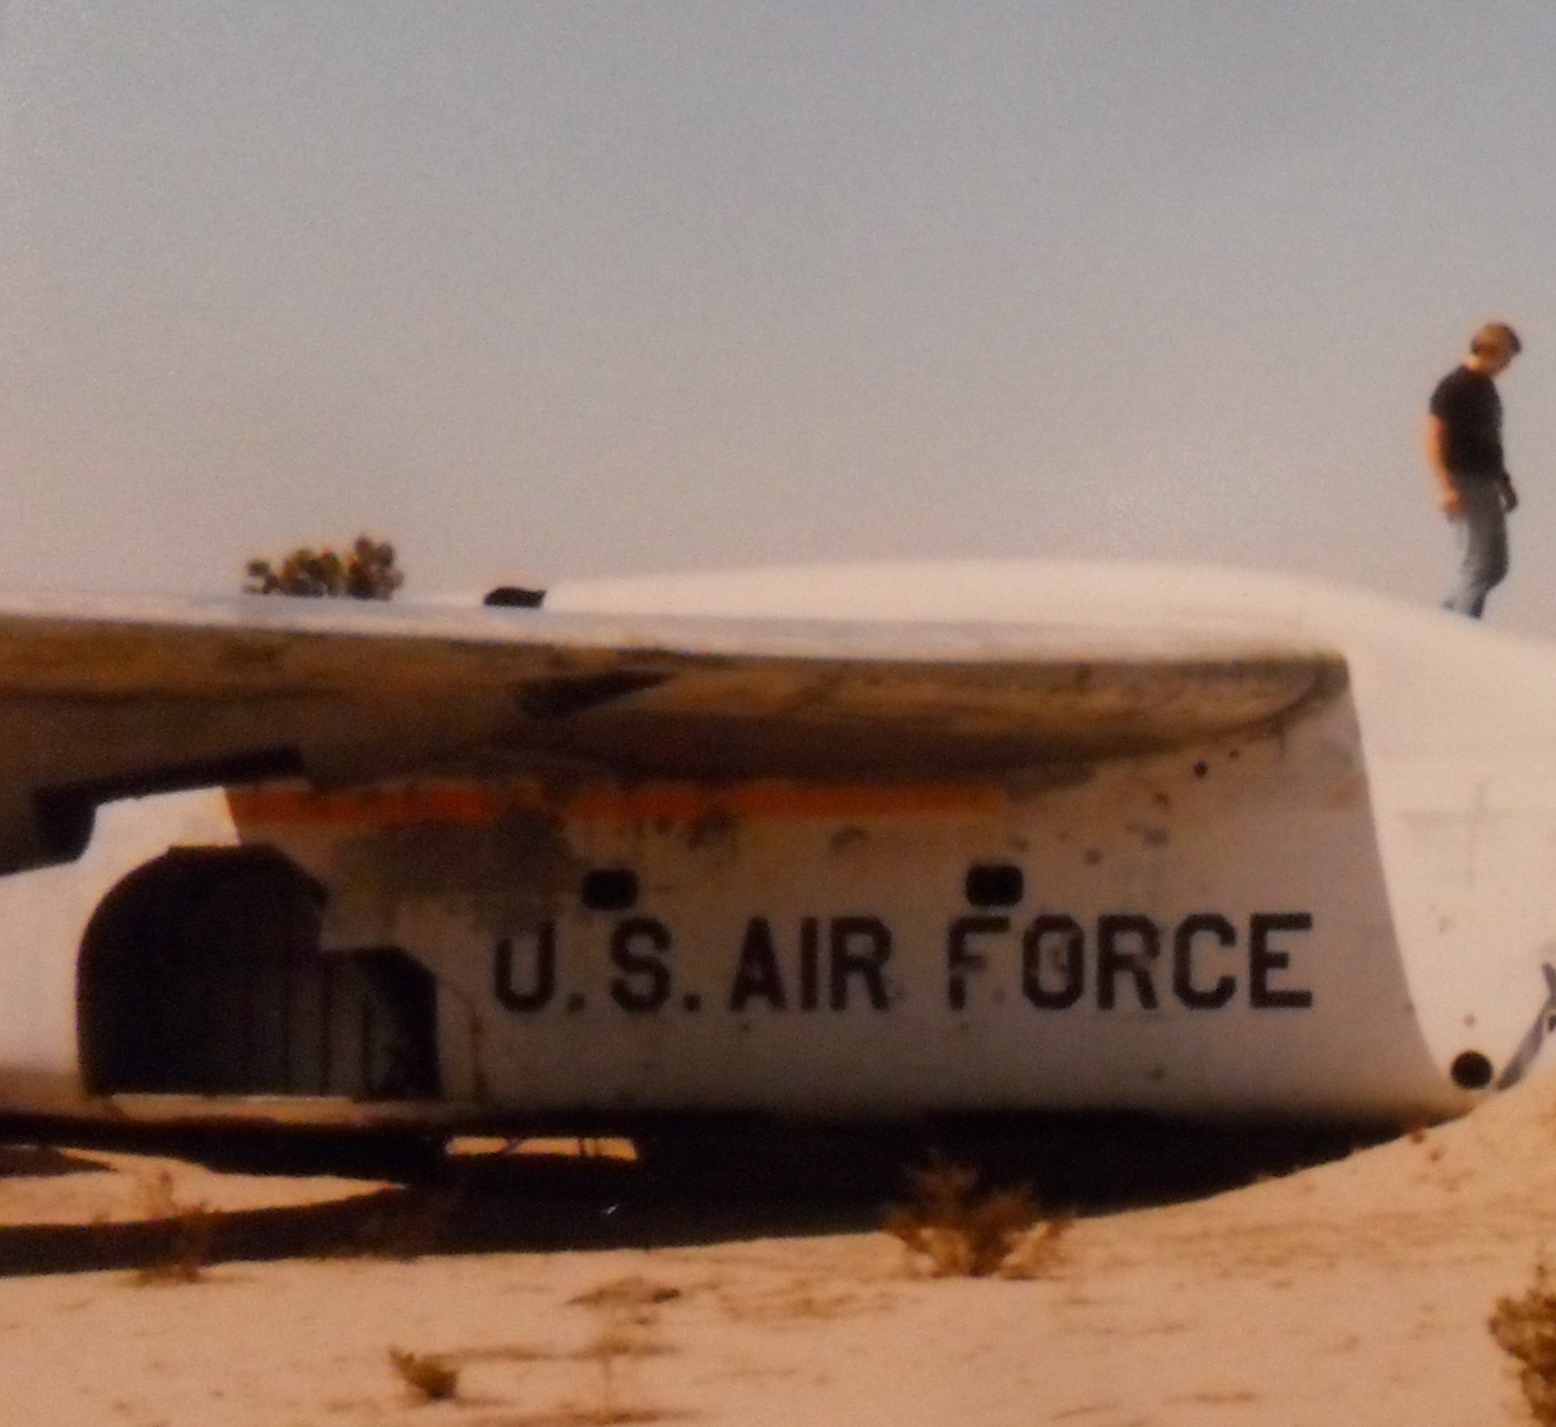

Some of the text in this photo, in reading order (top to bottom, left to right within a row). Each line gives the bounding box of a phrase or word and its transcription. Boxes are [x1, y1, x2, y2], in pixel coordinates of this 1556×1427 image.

[493, 911, 1313, 1014] U.S. AIR FORCE
